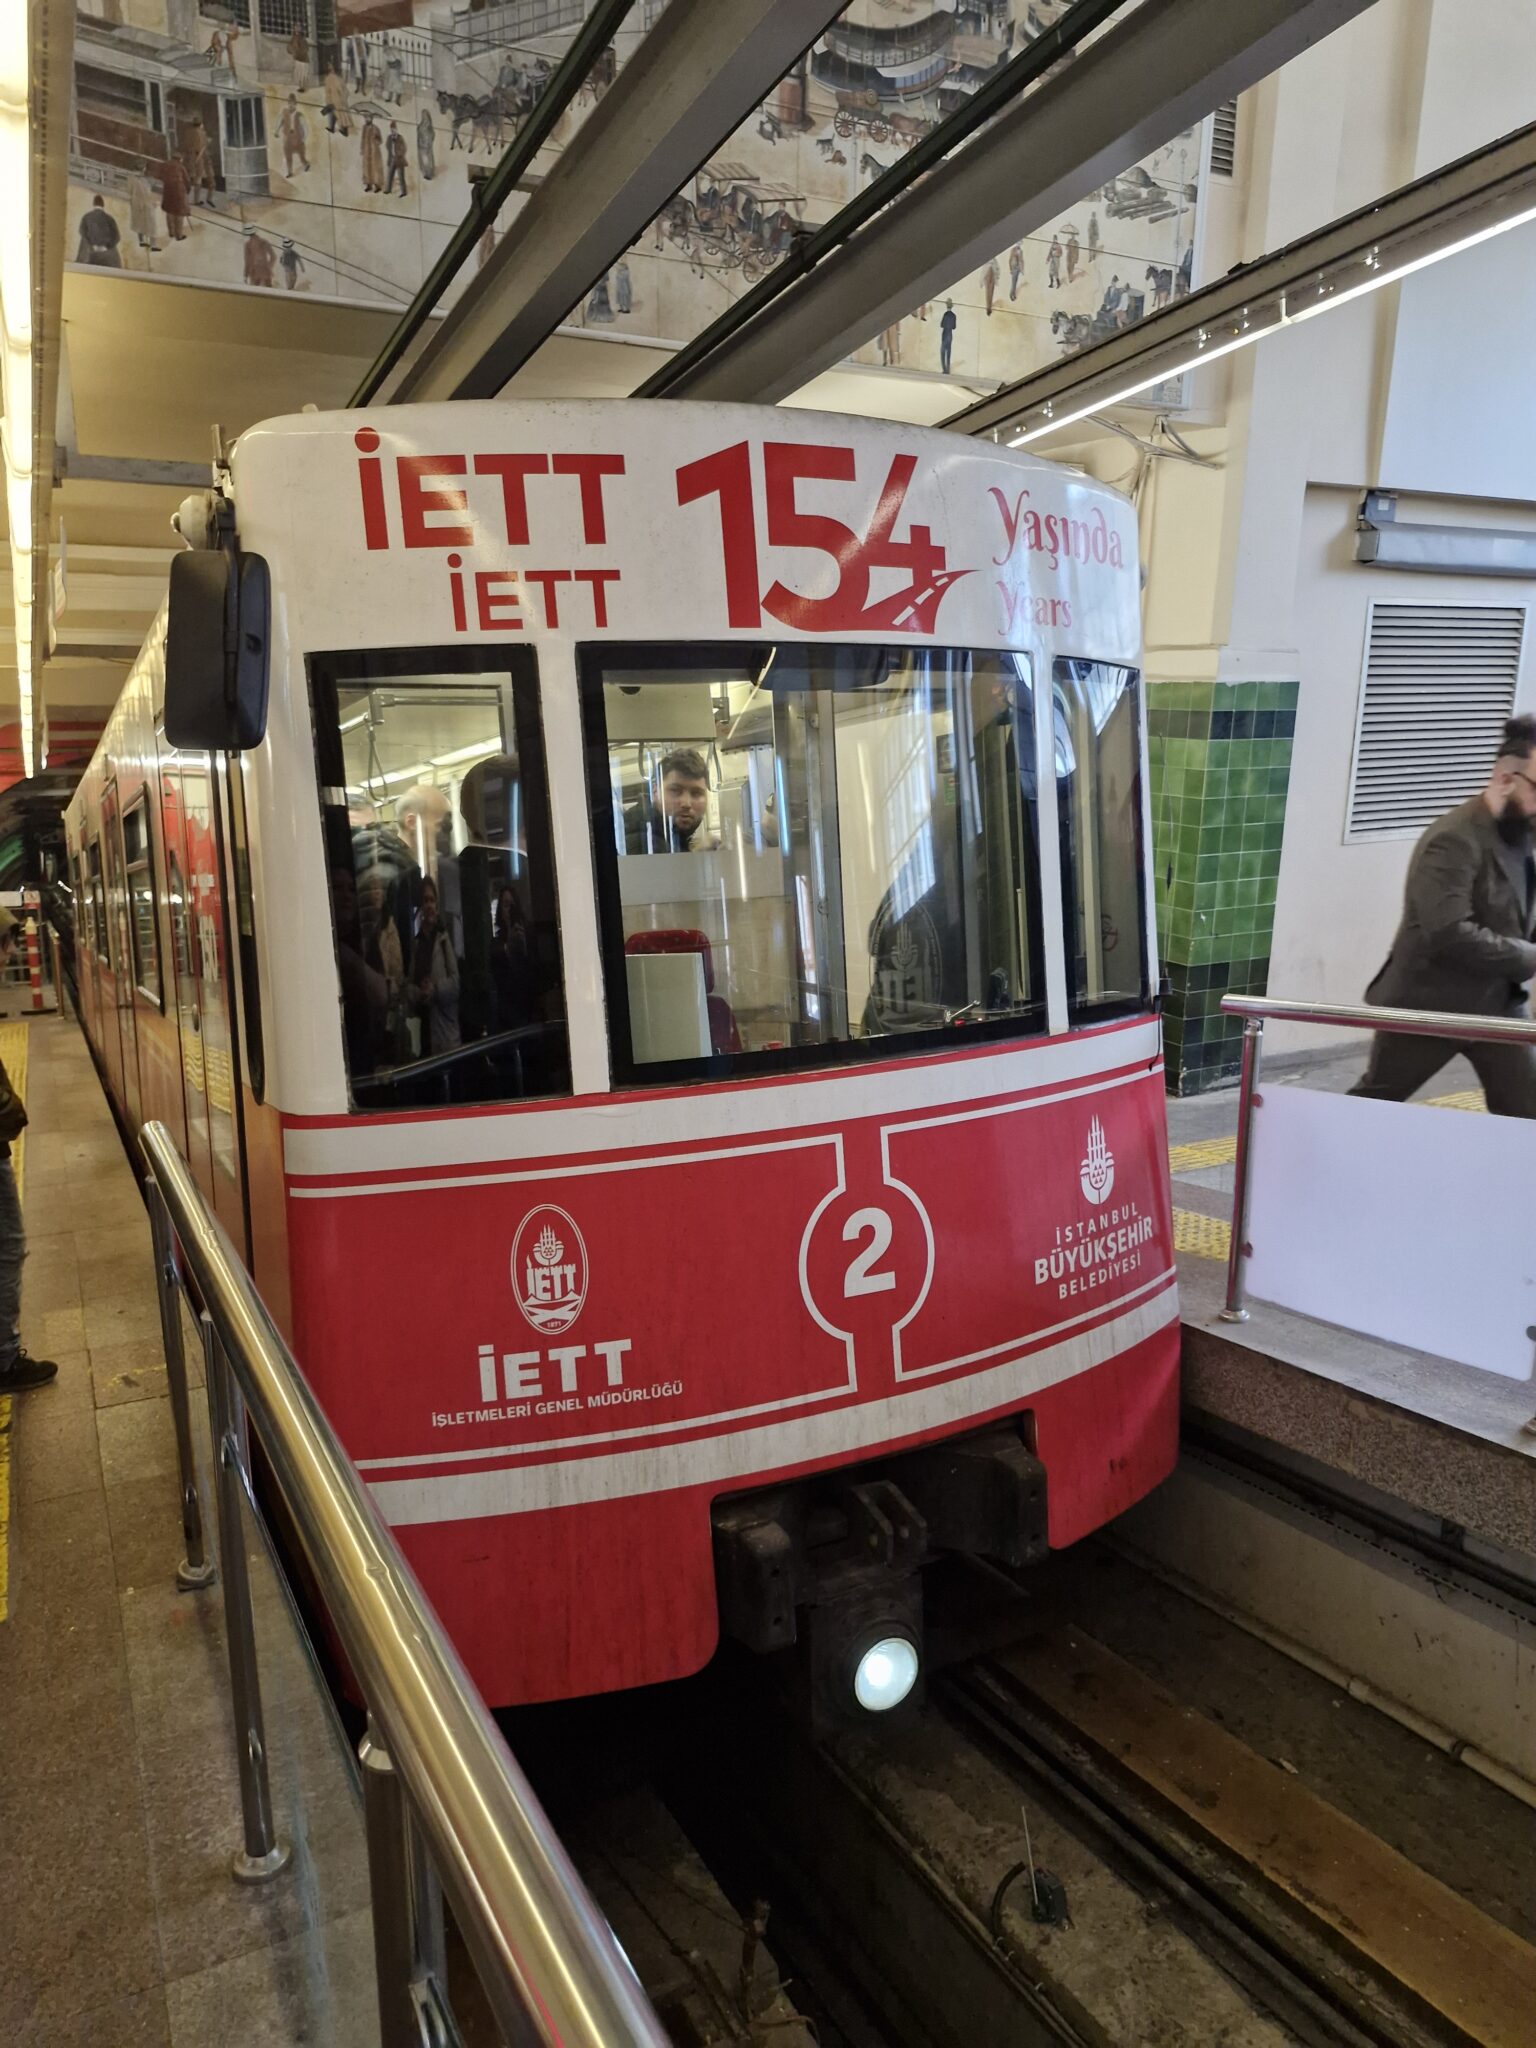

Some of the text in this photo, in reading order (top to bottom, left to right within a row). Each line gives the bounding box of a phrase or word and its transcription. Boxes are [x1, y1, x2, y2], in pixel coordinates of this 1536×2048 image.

[354, 427, 1123, 634] İETT 154 Yaşında
[447, 553, 621, 632] İETT
[842, 1207, 896, 1298] 2
[1034, 1216, 1153, 1285] BÜYÜKŞEHİR
[1056, 1202, 1139, 1245] İSTANBUL
[1059, 1249, 1141, 1299] BELEDİYESİ
[478, 1338, 632, 1402] İETT
[432, 1380, 683, 1428] İŞLETMELERİ GENEL MÜDÜRLÜĞÜ
